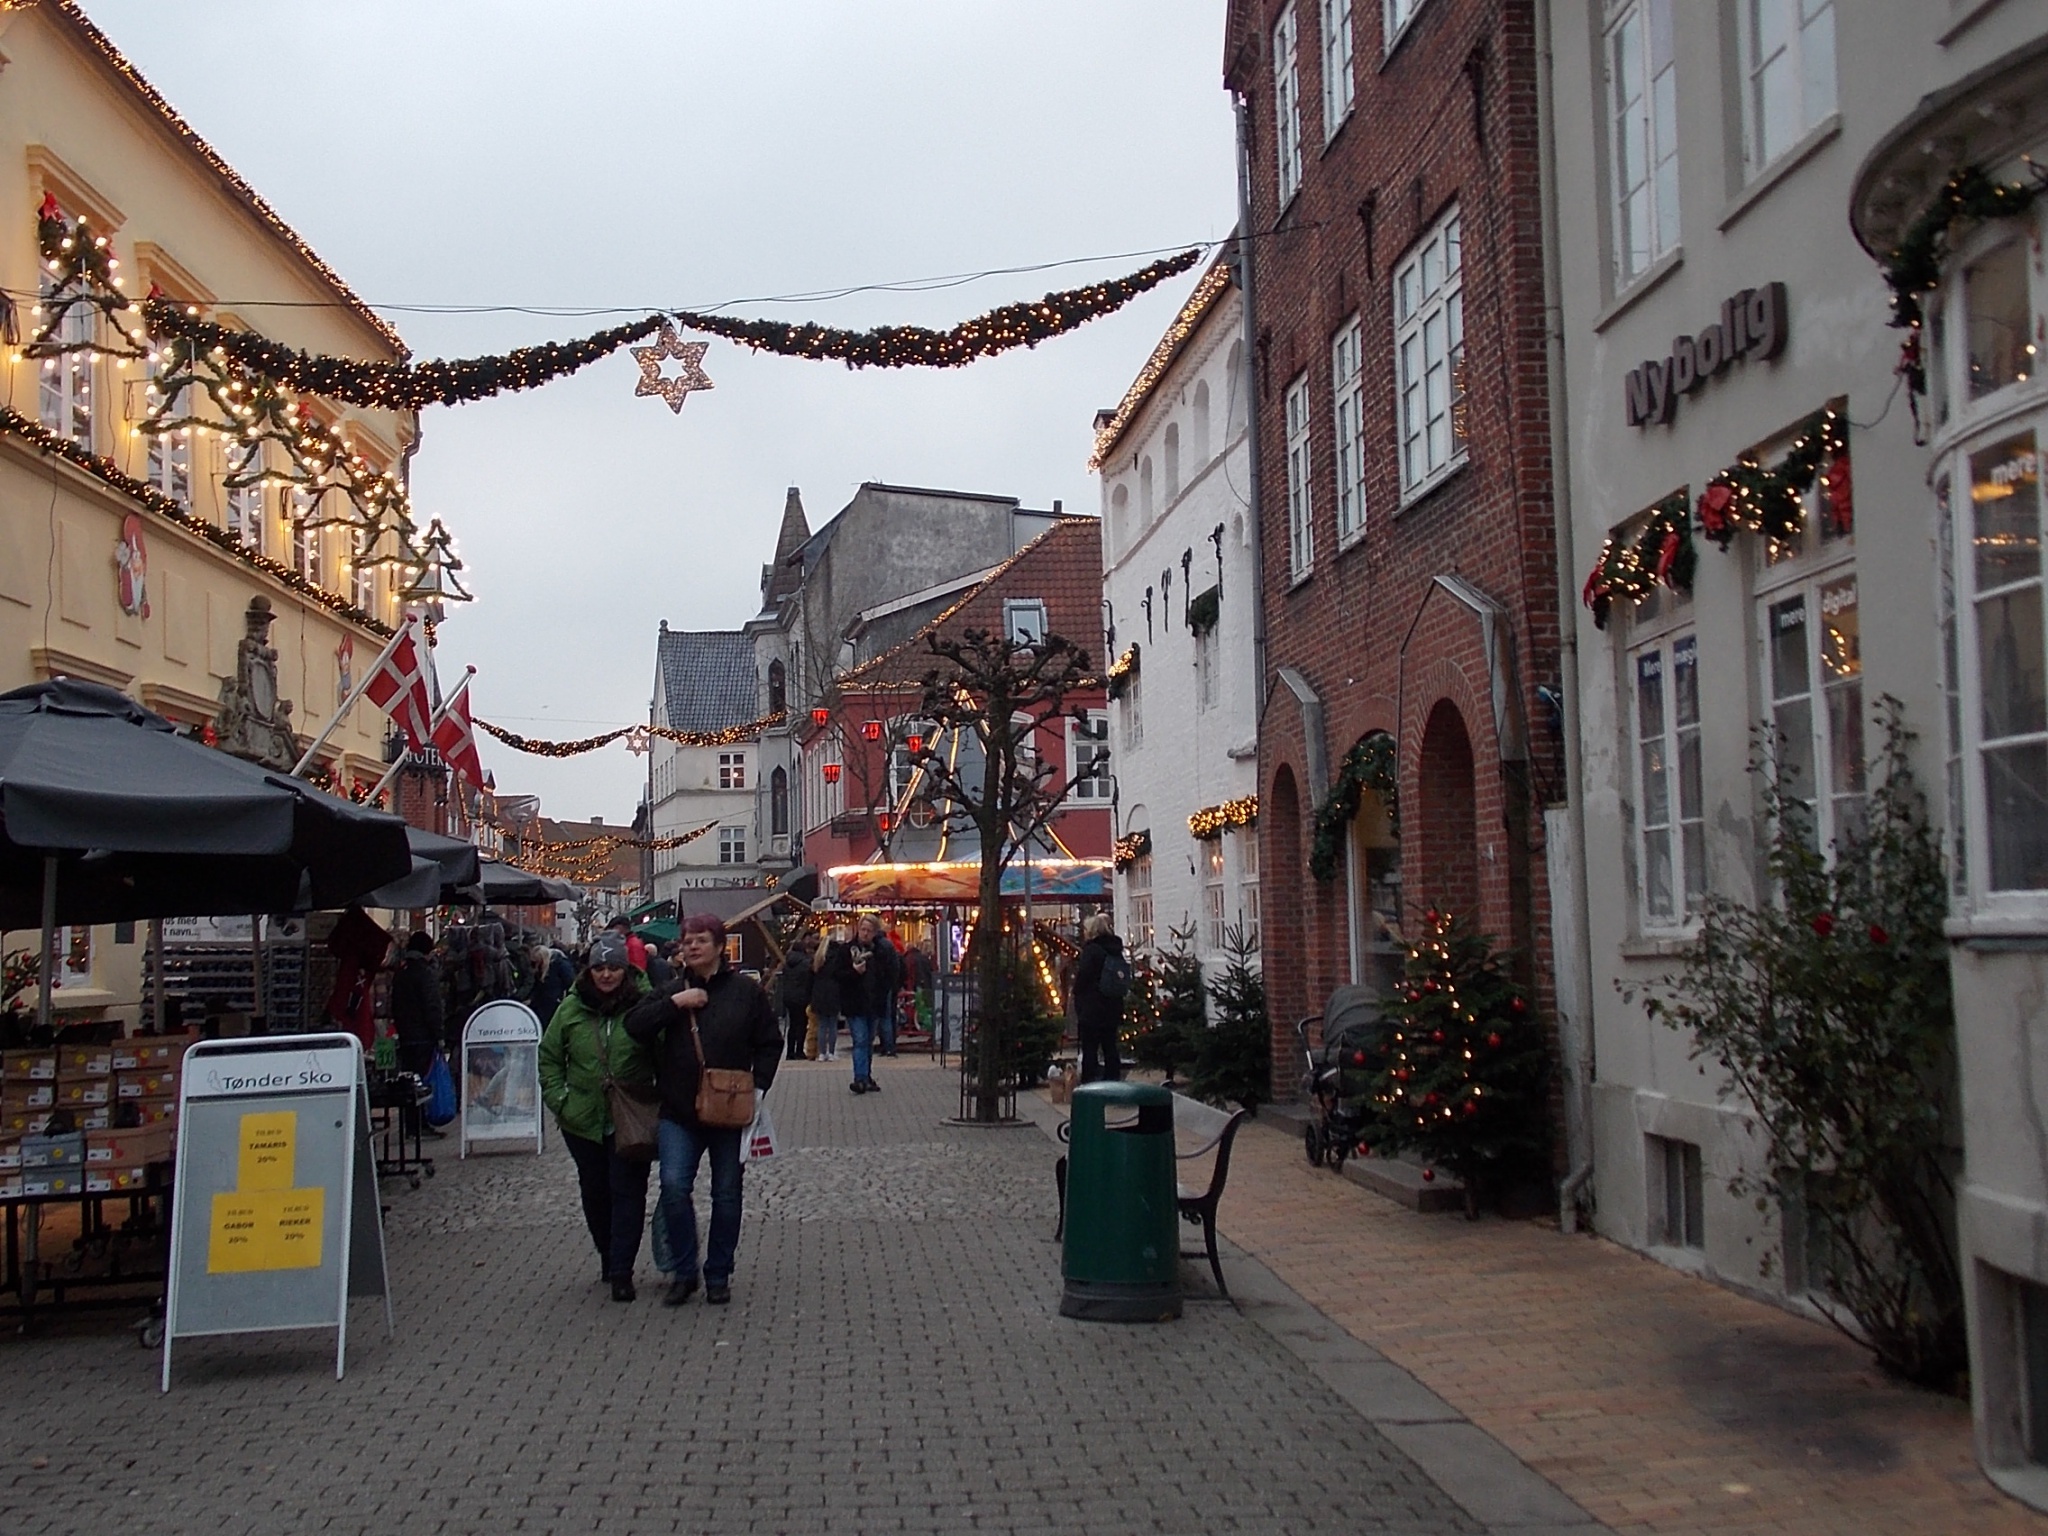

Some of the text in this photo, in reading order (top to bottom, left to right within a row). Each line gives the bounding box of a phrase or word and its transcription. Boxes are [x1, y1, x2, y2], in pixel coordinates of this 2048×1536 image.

[1625, 282, 1787, 427] Nybolig
[1781, 583, 1857, 628] mere digital
[402, 745, 444, 766] POTEK
[684, 877, 757, 888] VICTRIA
[478, 1026, 536, 1036] Tønder Sko
[222, 1071, 332, 1090] Tønder Sko
[223, 1222, 254, 1230] GABOR
[279, 1219, 311, 1227] RIEKER
